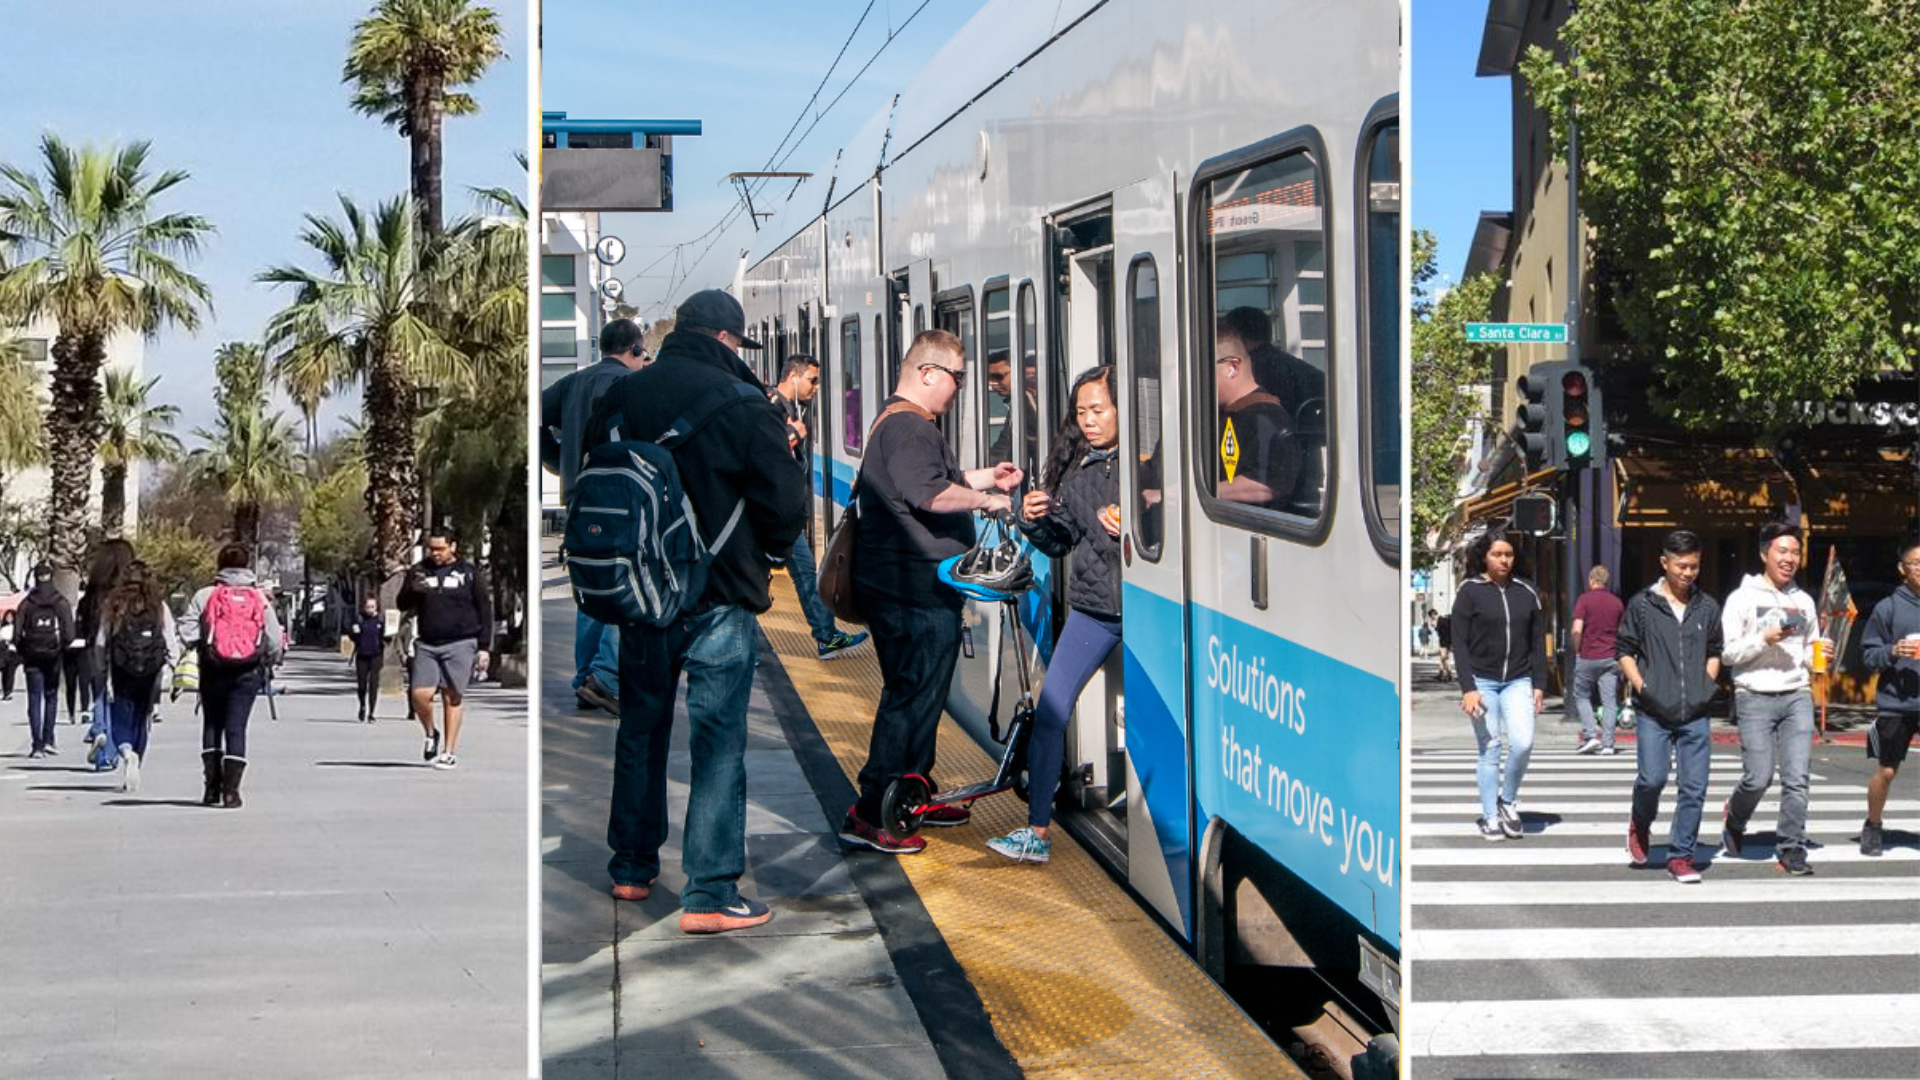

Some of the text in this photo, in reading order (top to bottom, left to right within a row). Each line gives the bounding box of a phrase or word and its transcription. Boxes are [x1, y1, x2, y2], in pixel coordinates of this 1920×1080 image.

[1479, 326, 1516, 339] Santa
[1519, 326, 1550, 339] Clara
[1207, 634, 1306, 735] Solutions
[1221, 725, 1395, 887] that move you
